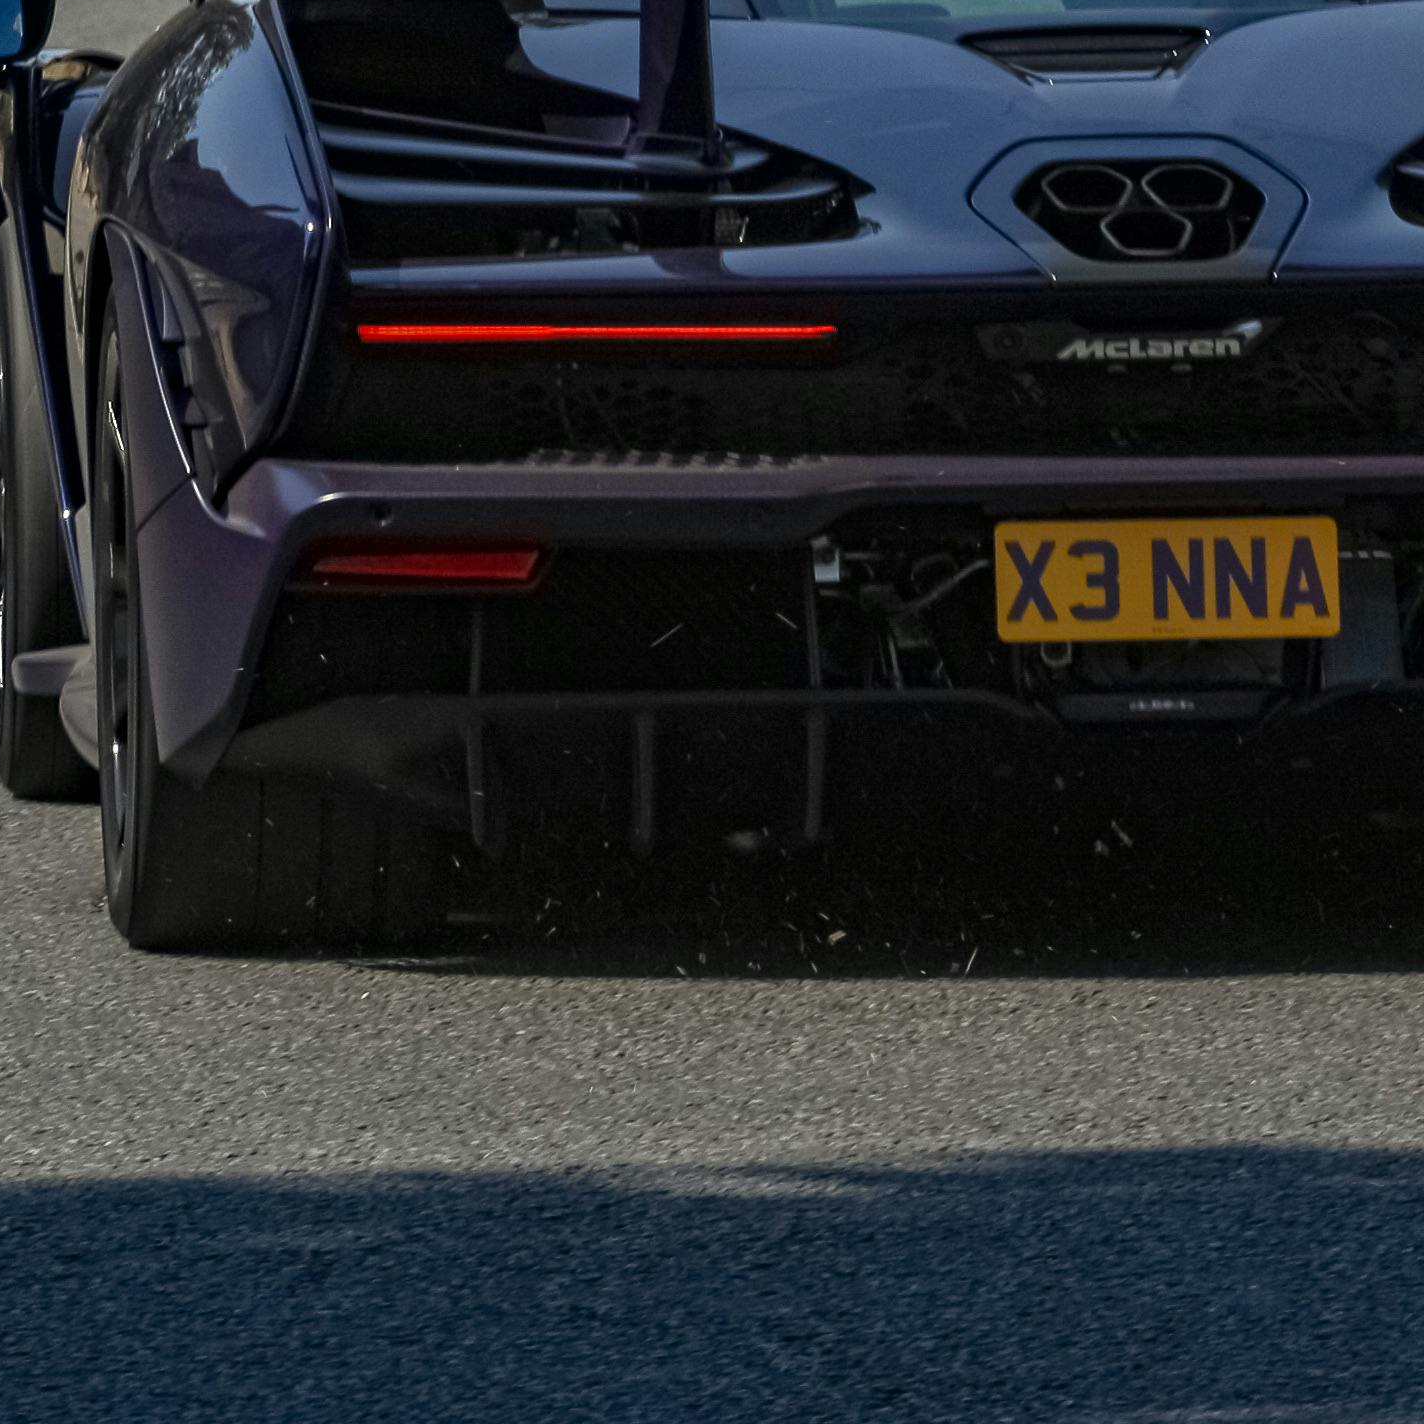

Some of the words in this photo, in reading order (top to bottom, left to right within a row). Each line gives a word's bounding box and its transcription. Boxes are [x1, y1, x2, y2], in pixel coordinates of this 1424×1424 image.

[1056, 335, 1242, 361] McLaren
[1005, 538, 1120, 623] X3
[1151, 536, 1331, 621] NNA
